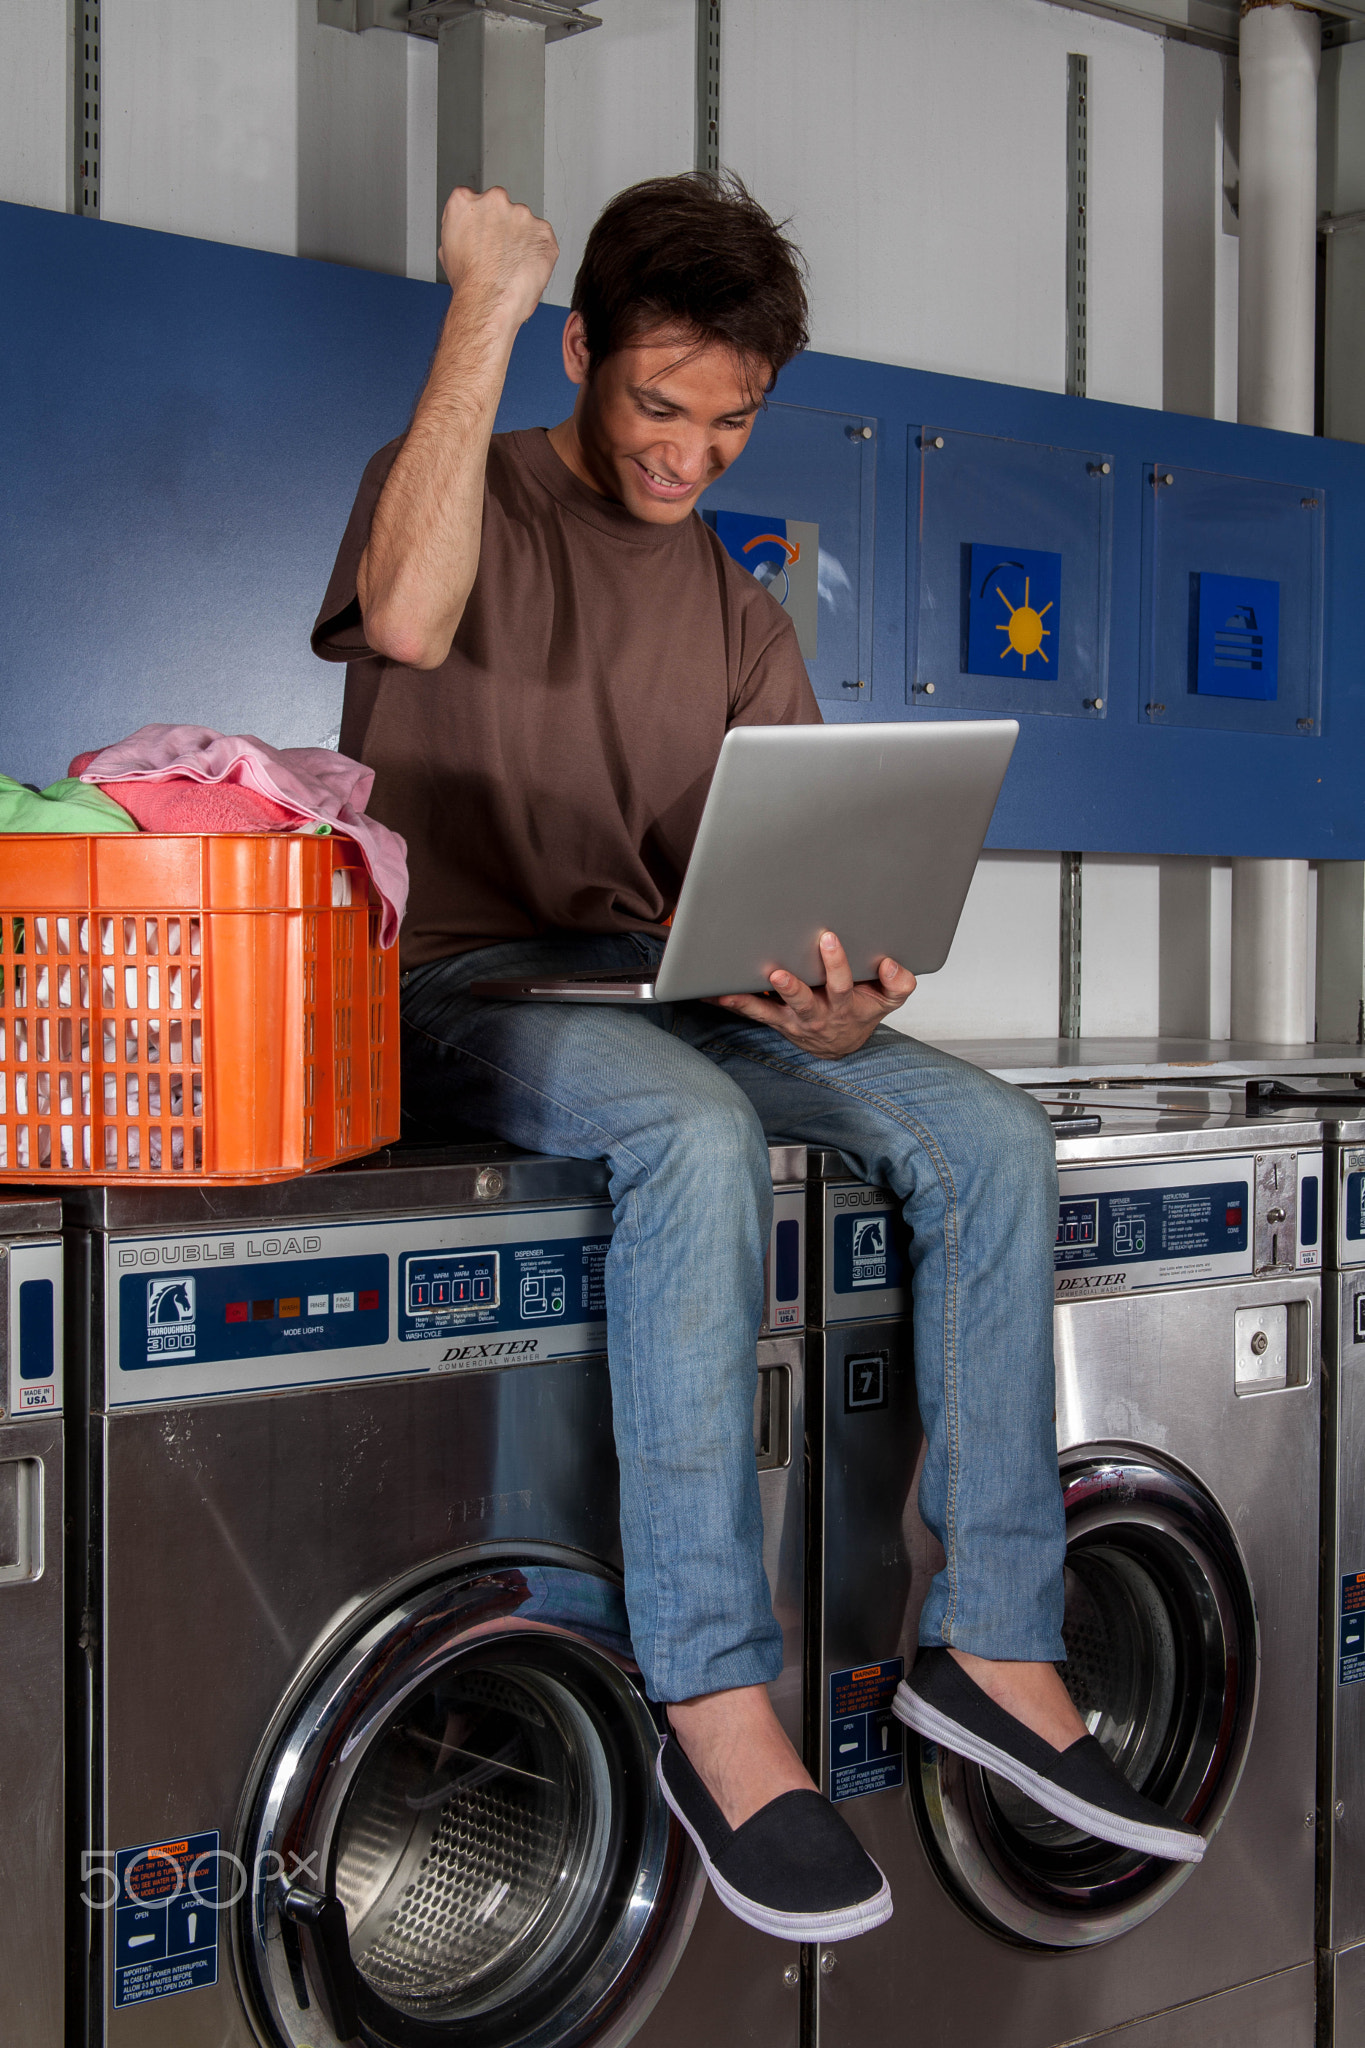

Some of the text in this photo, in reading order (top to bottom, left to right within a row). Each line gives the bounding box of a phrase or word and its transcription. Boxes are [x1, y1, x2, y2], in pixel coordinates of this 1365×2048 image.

[834, 1191, 894, 1207] DOUBL
[119, 1236, 322, 1267] DOUBLE LOAD
[515, 1249, 543, 1257] DISPENSER
[853, 1264, 886, 1278] 300
[1057, 1273, 1126, 1290] DEXTER
[1056, 1290, 1097, 1298] COMMERCIAL
[147, 1324, 196, 1336] THOROUGHBRED
[283, 1326, 324, 1336] MODE LIGHTS
[424, 1330, 442, 1338] CYCLE
[147, 1333, 196, 1352] 300
[440, 1339, 538, 1362] DEXTER
[438, 1353, 540, 1371] COMMERCIAL WASHER
[860, 1371, 873, 1393] 7
[24, 1389, 42, 1397] MADE
[26, 1395, 48, 1406] USA
[854, 1668, 879, 1678] WARNING
[151, 1844, 185, 1857] WARNING
[165, 1858, 179, 1866] OPEN
[180, 1855, 194, 1863] DOOR
[141, 1872, 155, 1881] DRUM
[163, 1866, 185, 1875] TURNING
[153, 1877, 169, 1885] WATER
[177, 1873, 187, 1881] THE
[188, 1868, 209, 1877] WINDOW
[156, 1885, 170, 1893] LIGHT
[182, 1899, 204, 1909] LATCHED
[134, 1911, 149, 1920] OPEN
[123, 1965, 153, 1978] IMPORTANT:
[130, 1975, 143, 1983] CASE
[153, 1968, 171, 1979] POWER
[123, 1984, 141, 1994] ALLOW
[150, 1976, 172, 1988] MINUTES
[173, 1971, 193, 1980] BEFORE
[123, 1989, 154, 2001] ATTEMPTING
[163, 1983, 178, 1991] OPEN
